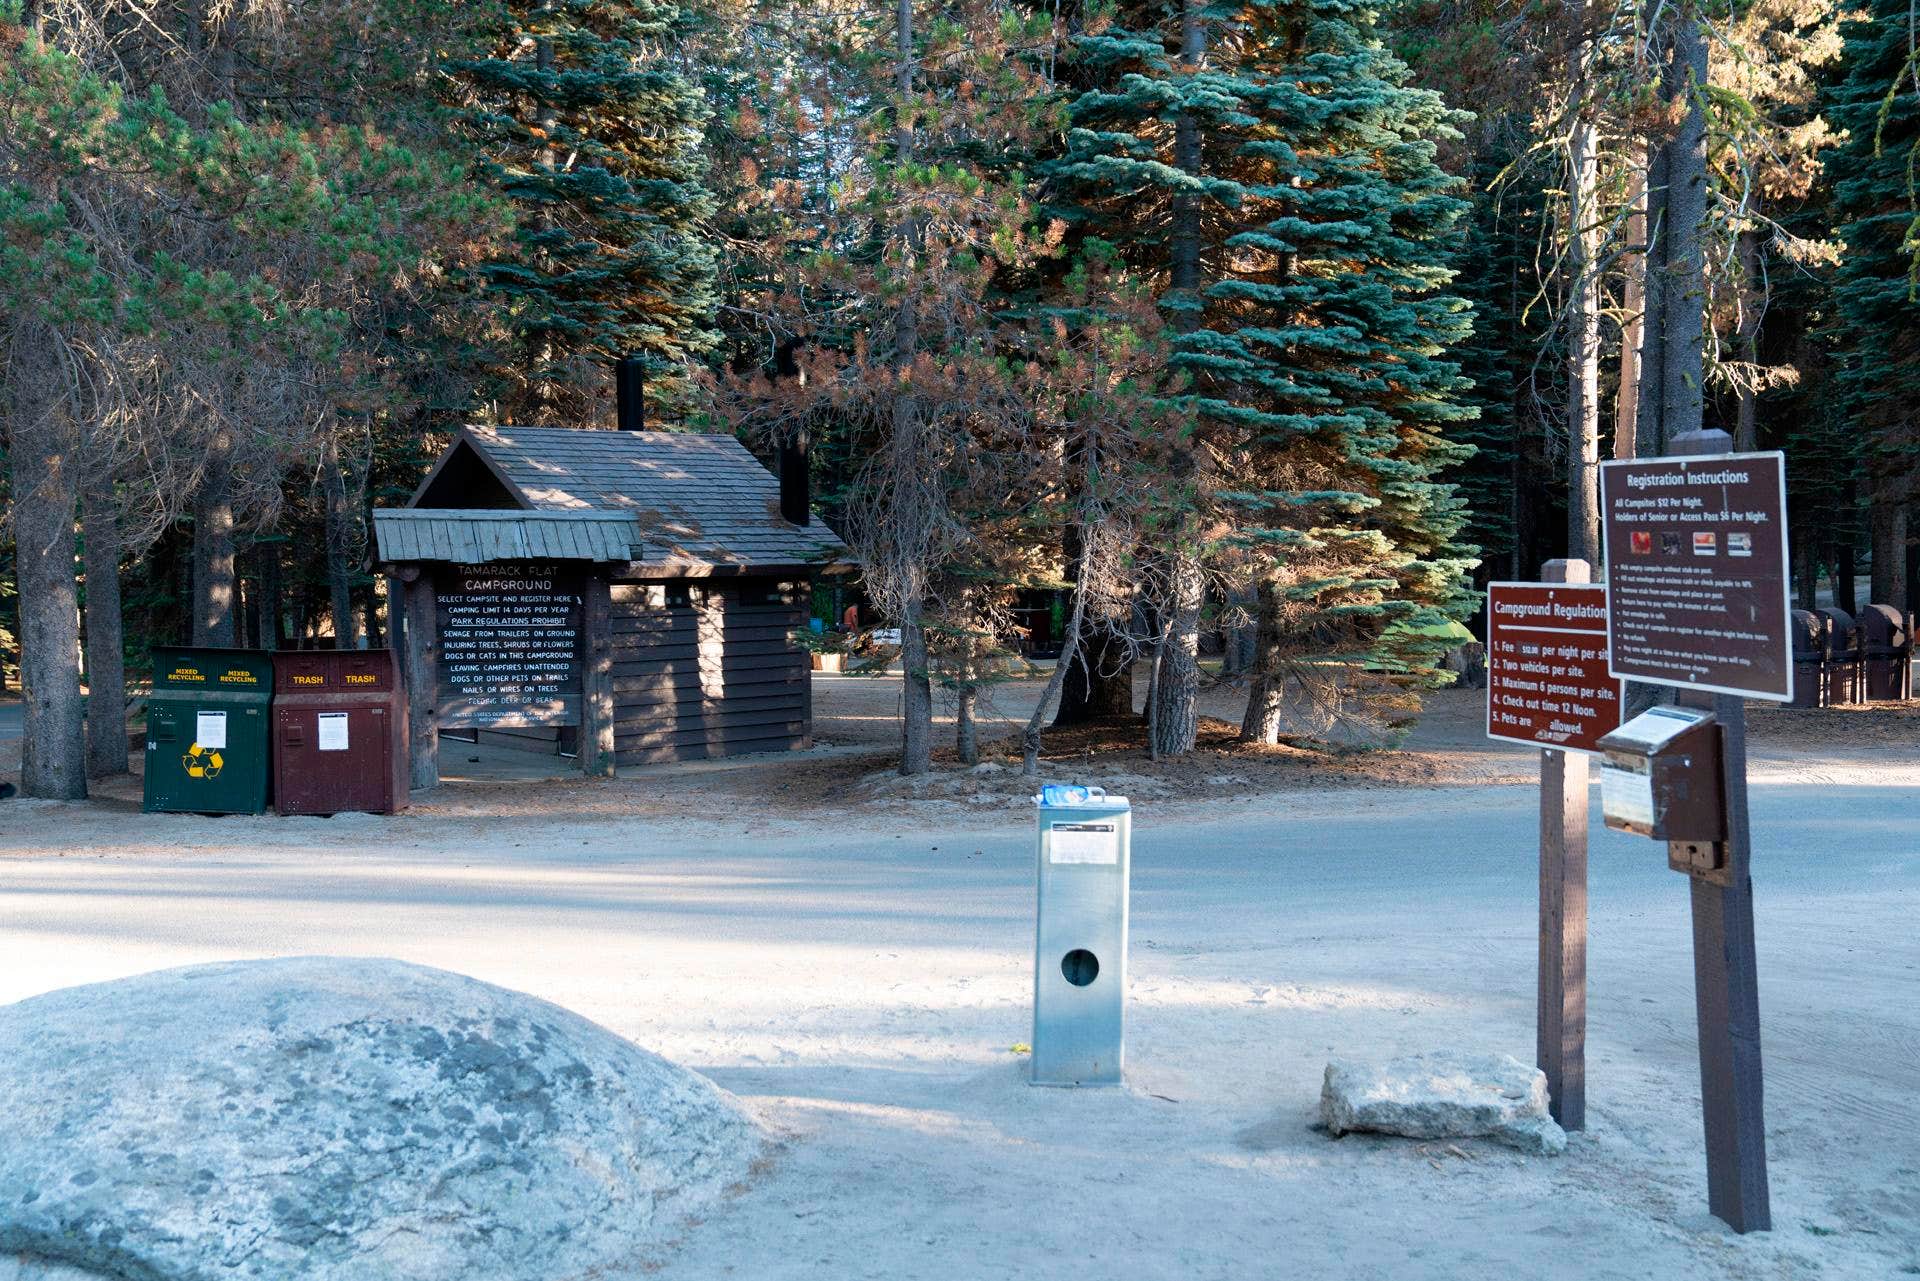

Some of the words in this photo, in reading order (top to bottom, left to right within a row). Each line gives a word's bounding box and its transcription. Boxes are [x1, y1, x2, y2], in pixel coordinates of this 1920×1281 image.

[1627, 473, 1684, 490] Registration
[1688, 470, 1748, 485] Instructions
[1625, 499, 1655, 509] Campsites
[1671, 498, 1681, 507] Per
[1683, 498, 1703, 508] Night.
[1615, 513, 1638, 521] Holders
[1639, 513, 1646, 521] of
[1648, 512, 1668, 521] Senior
[1680, 512, 1701, 520] Access
[1704, 512, 1718, 520] Pass
[1732, 512, 1743, 520] Per
[1746, 511, 1768, 523] Night.
[458, 566, 520, 576] TAMARACK
[529, 566, 558, 576] FLAT
[466, 580, 552, 590] CAMPGROUND
[1495, 602, 1550, 618] Campground
[1554, 603, 1606, 620] Regulation
[1494, 641, 1498, 650] 1.
[1502, 642, 1514, 652] Fee
[1542, 646, 1555, 657] per
[1558, 645, 1578, 660] night
[1582, 649, 1595, 660] per
[1598, 648, 1608, 660] sit
[1494, 659, 1499, 668] 2.
[1503, 660, 1517, 670] Two
[1520, 662, 1549, 674] vehicles
[1552, 666, 1564, 678] per
[1568, 665, 1585, 677] site.
[1494, 677, 1499, 686] 3.
[1502, 678, 1537, 690] Maximum
[1540, 682, 1544, 691] 6
[1548, 684, 1577, 695] persons
[1581, 686, 1594, 698] per
[1598, 686, 1616, 700] site.
[1494, 694, 1500, 704] 4.
[1503, 696, 1523, 708] Check
[1526, 699, 1539, 709] out
[1542, 700, 1559, 712] time
[1562, 703, 1570, 713] 12
[1573, 704, 1596, 717] Noon.
[1493, 712, 1498, 722] 5.
[1502, 713, 1517, 724] Pets
[1519, 716, 1531, 726] are
[1550, 720, 1583, 734] allowed.
